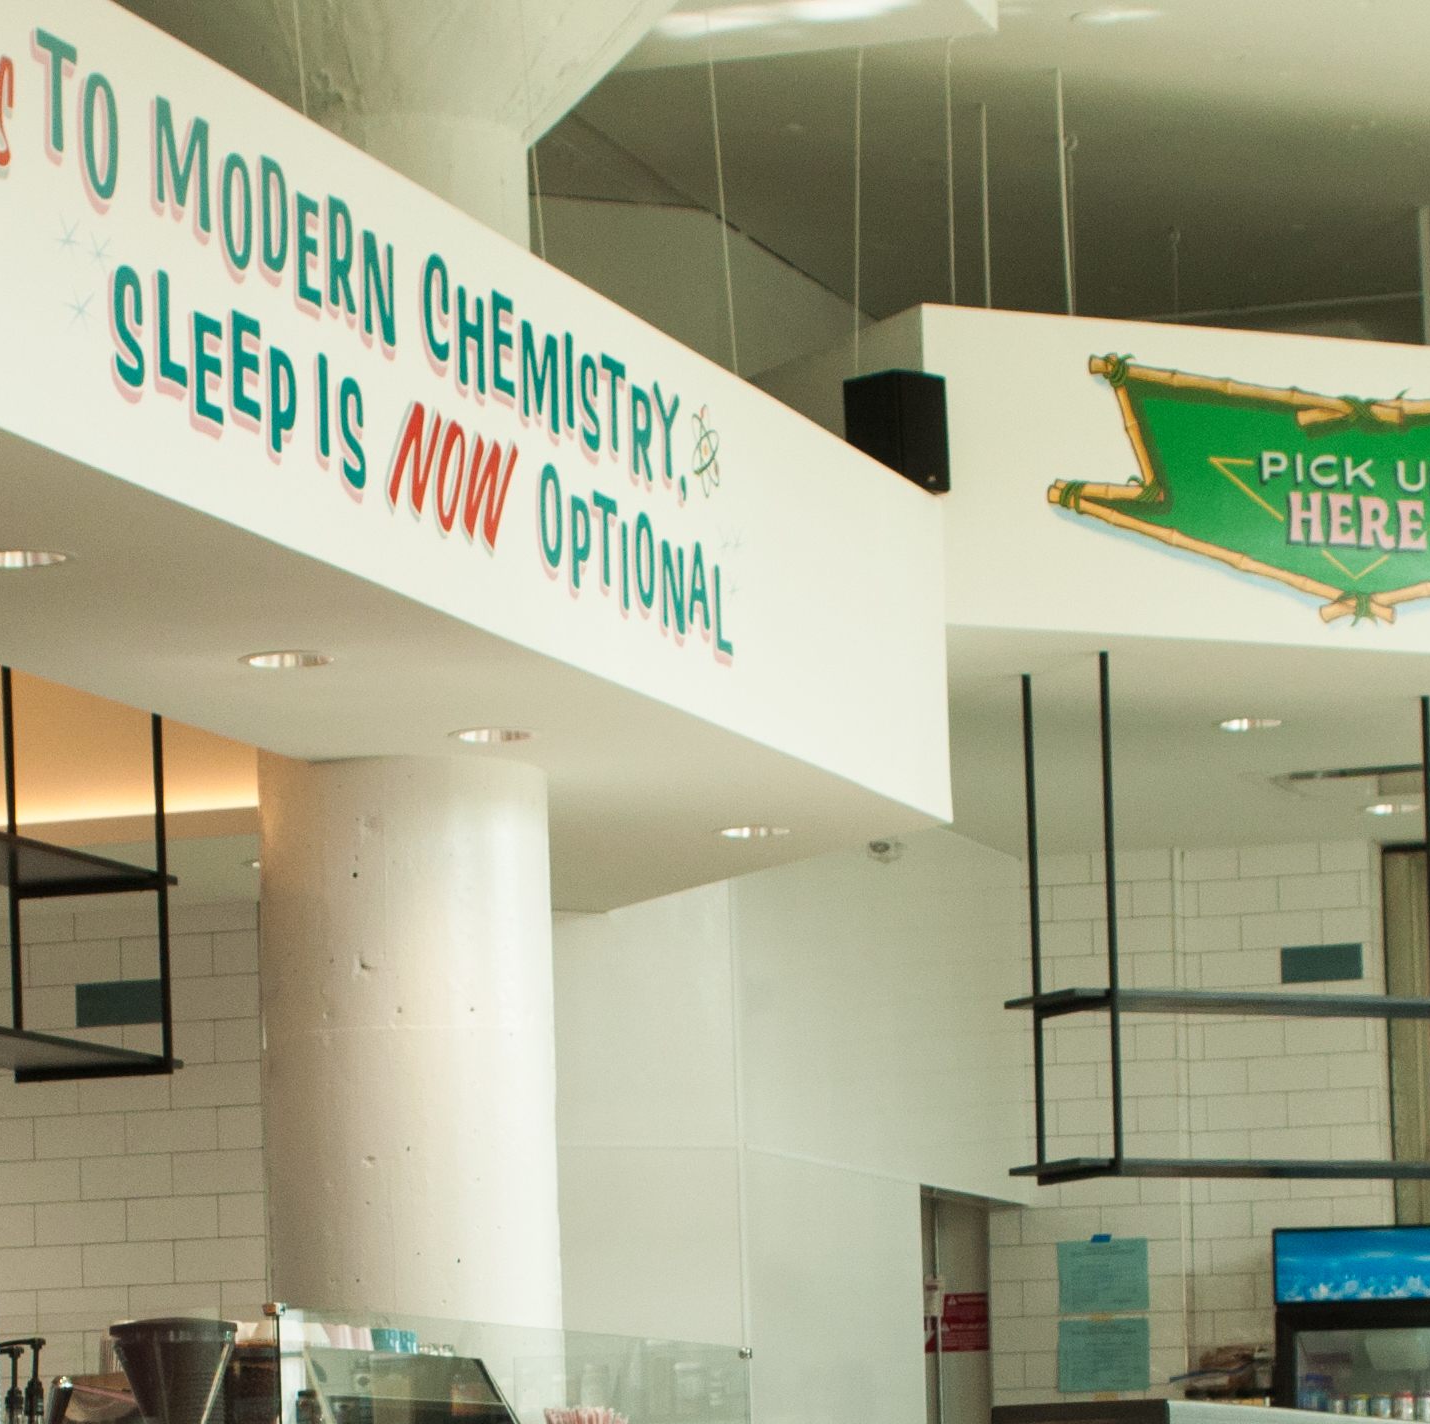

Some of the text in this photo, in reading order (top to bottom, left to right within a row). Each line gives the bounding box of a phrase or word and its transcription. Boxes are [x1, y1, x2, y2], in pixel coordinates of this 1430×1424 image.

[33, 28, 118, 200] TO
[152, 96, 396, 347] MODERN
[111, 264, 733, 655] SLEEP IS NOW OPTIONAL
[1261, 450, 1374, 489] PICK
[1287, 491, 1427, 550] HERE
